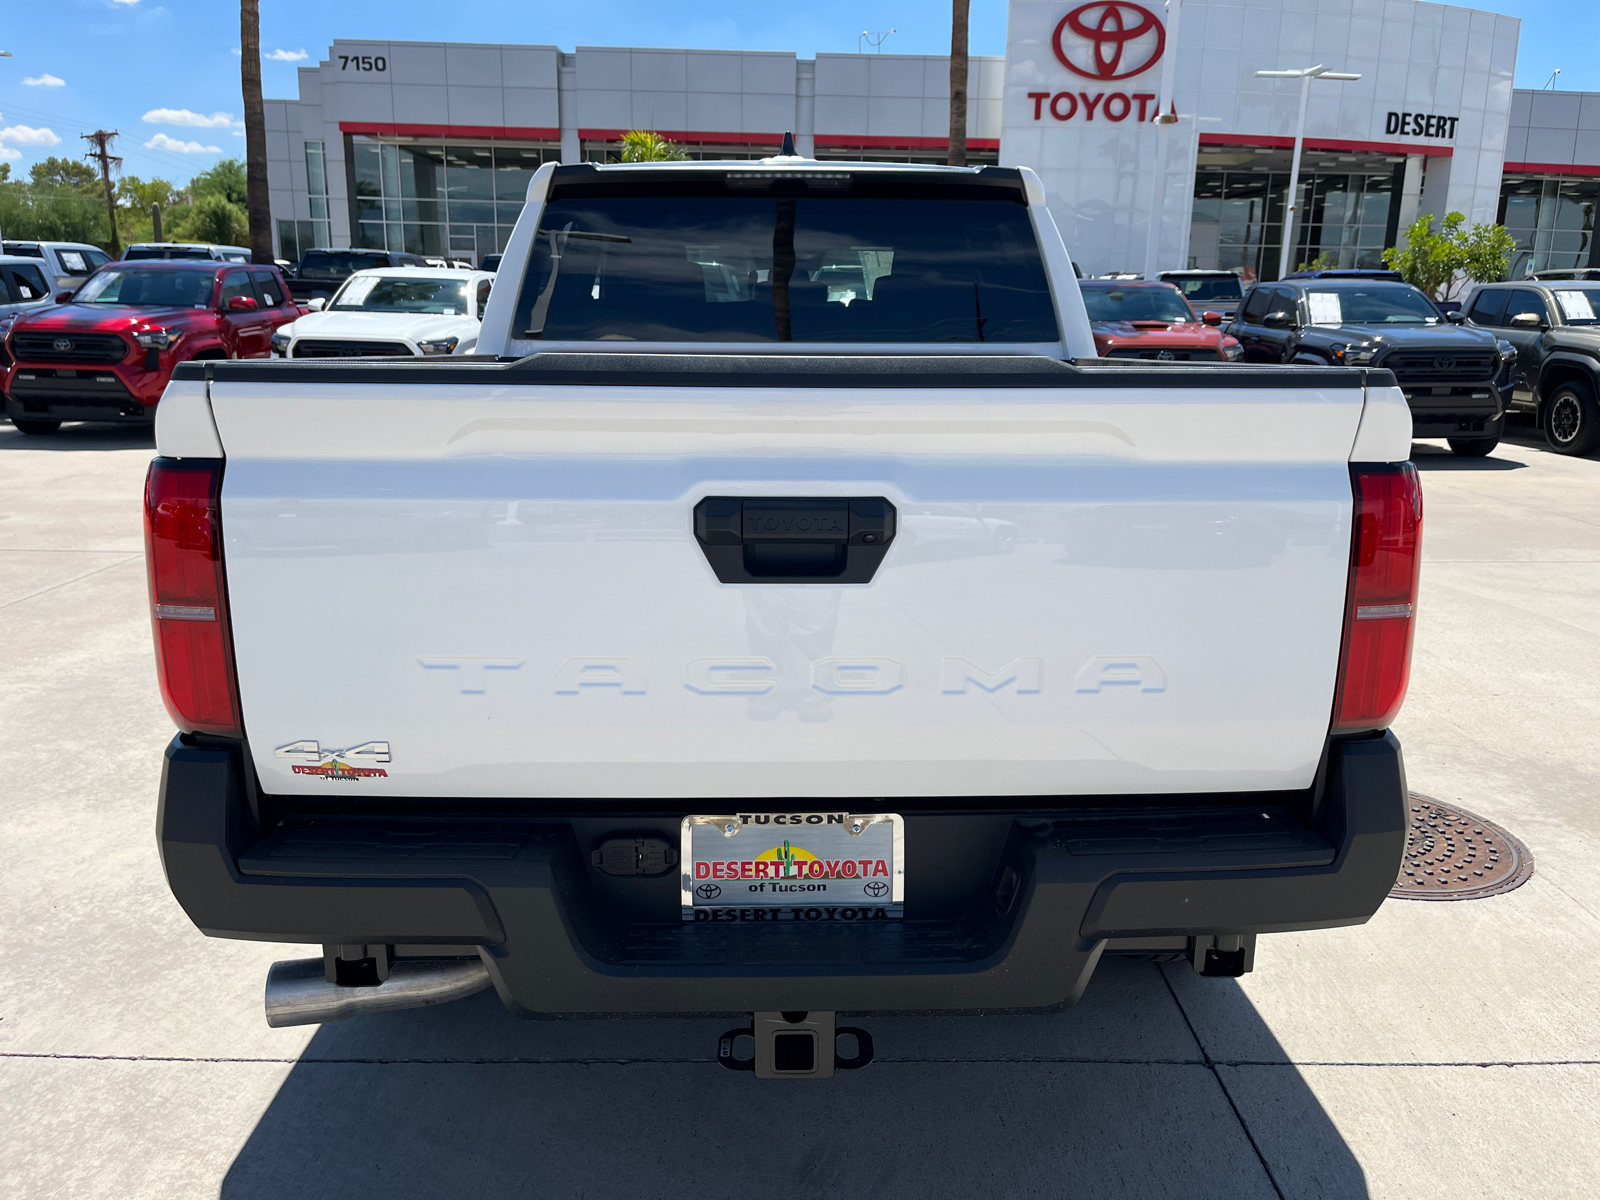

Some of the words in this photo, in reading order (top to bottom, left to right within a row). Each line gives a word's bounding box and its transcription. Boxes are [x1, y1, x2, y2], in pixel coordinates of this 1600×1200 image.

[338, 55, 387, 72] 7150
[1385, 111, 1460, 139] DESERT
[749, 514, 844, 531] TOYOTA
[416, 655, 1167, 696] TACOMA
[291, 765, 337, 776] DESERT
[340, 767, 389, 778] TOYOTA
[739, 814, 845, 825] TUCSON
[695, 860, 785, 880] DESERT
[793, 859, 890, 880] TOYOTA
[748, 882, 766, 893] of
[768, 882, 827, 893] Tucson
[693, 908, 781, 922] DESERT
[791, 907, 888, 921] TOYOTA
